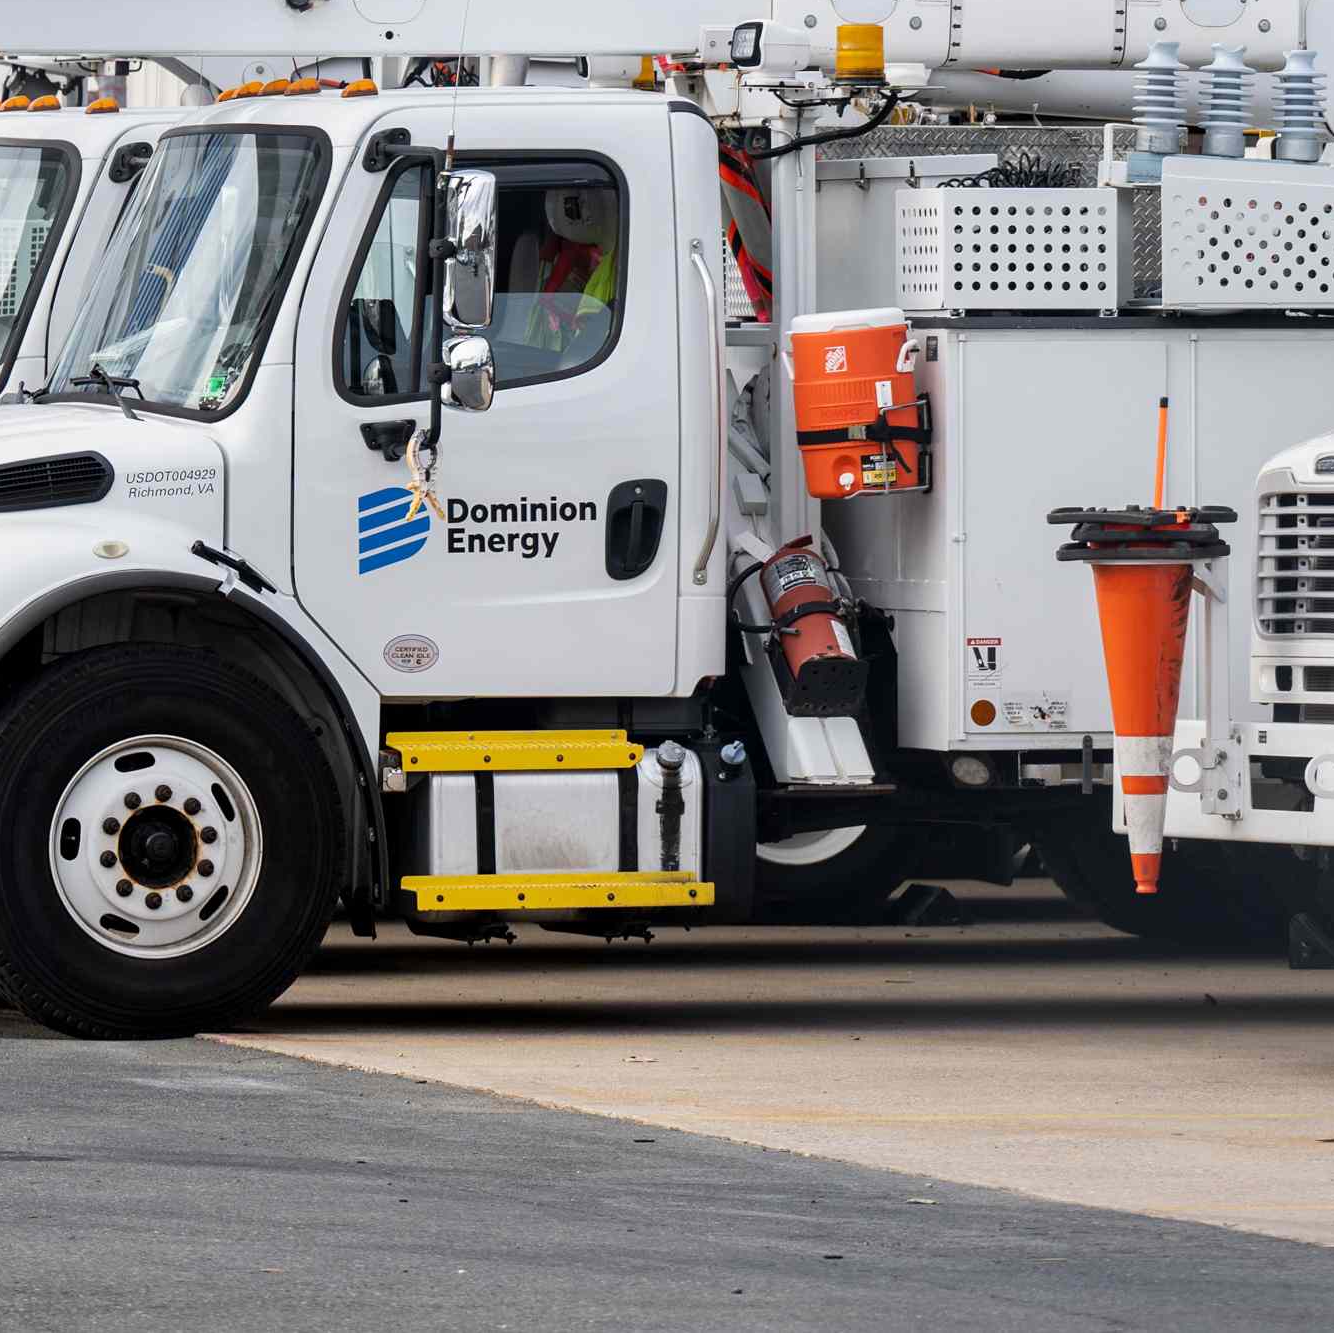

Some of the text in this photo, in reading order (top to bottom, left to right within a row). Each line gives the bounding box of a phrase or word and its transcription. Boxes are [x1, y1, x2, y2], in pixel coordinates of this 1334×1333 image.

[126, 468, 216, 484] USDOT004929
[128, 482, 214, 498] Richmond, VA
[447, 496, 597, 524] Dominion
[447, 528, 560, 559] Energy
